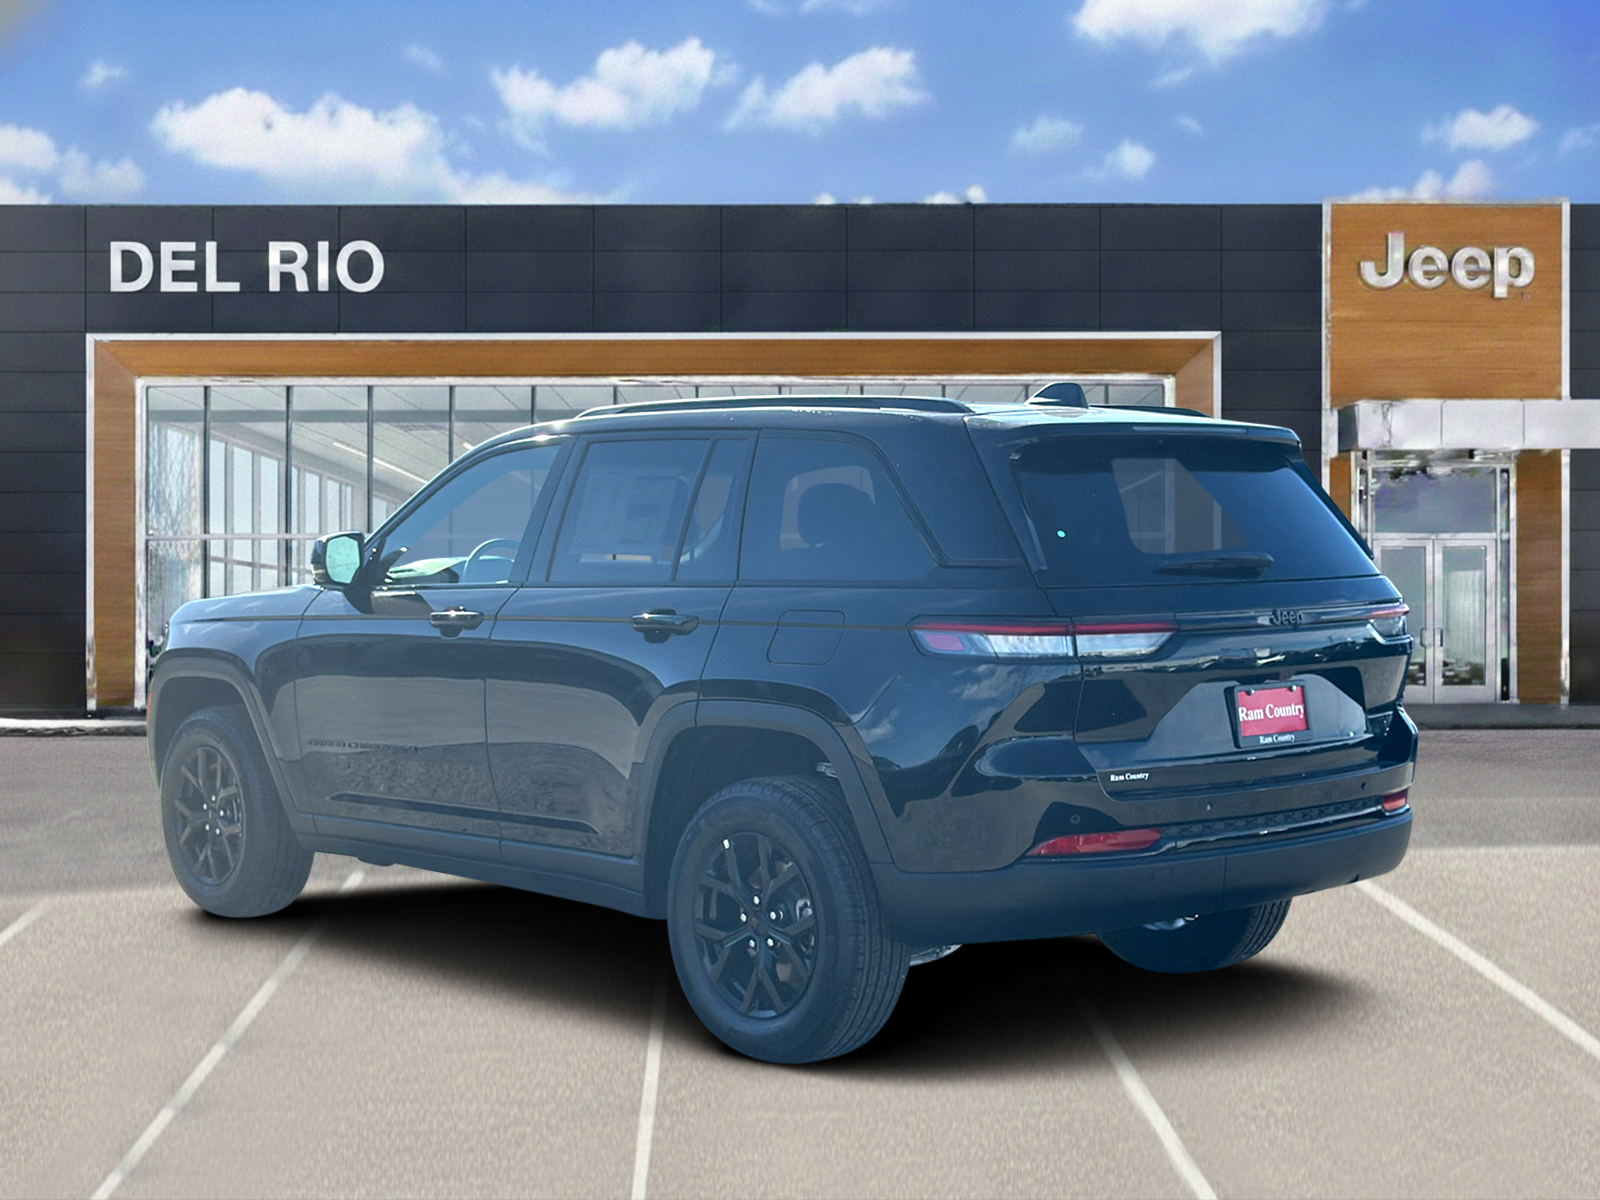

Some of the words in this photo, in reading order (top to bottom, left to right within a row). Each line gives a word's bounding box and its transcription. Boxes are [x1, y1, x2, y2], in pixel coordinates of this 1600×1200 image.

[110, 241, 241, 292] DEL
[268, 240, 385, 293] RIO
[1359, 231, 1536, 299] Jeep
[1269, 609, 1304, 628] Jeep
[1238, 706, 1264, 722] Ram
[1265, 703, 1305, 719] Country
[1259, 735, 1272, 745] Ram
[1273, 733, 1295, 743] Country
[1110, 774, 1125, 782] Ram
[1125, 772, 1149, 781] Country
